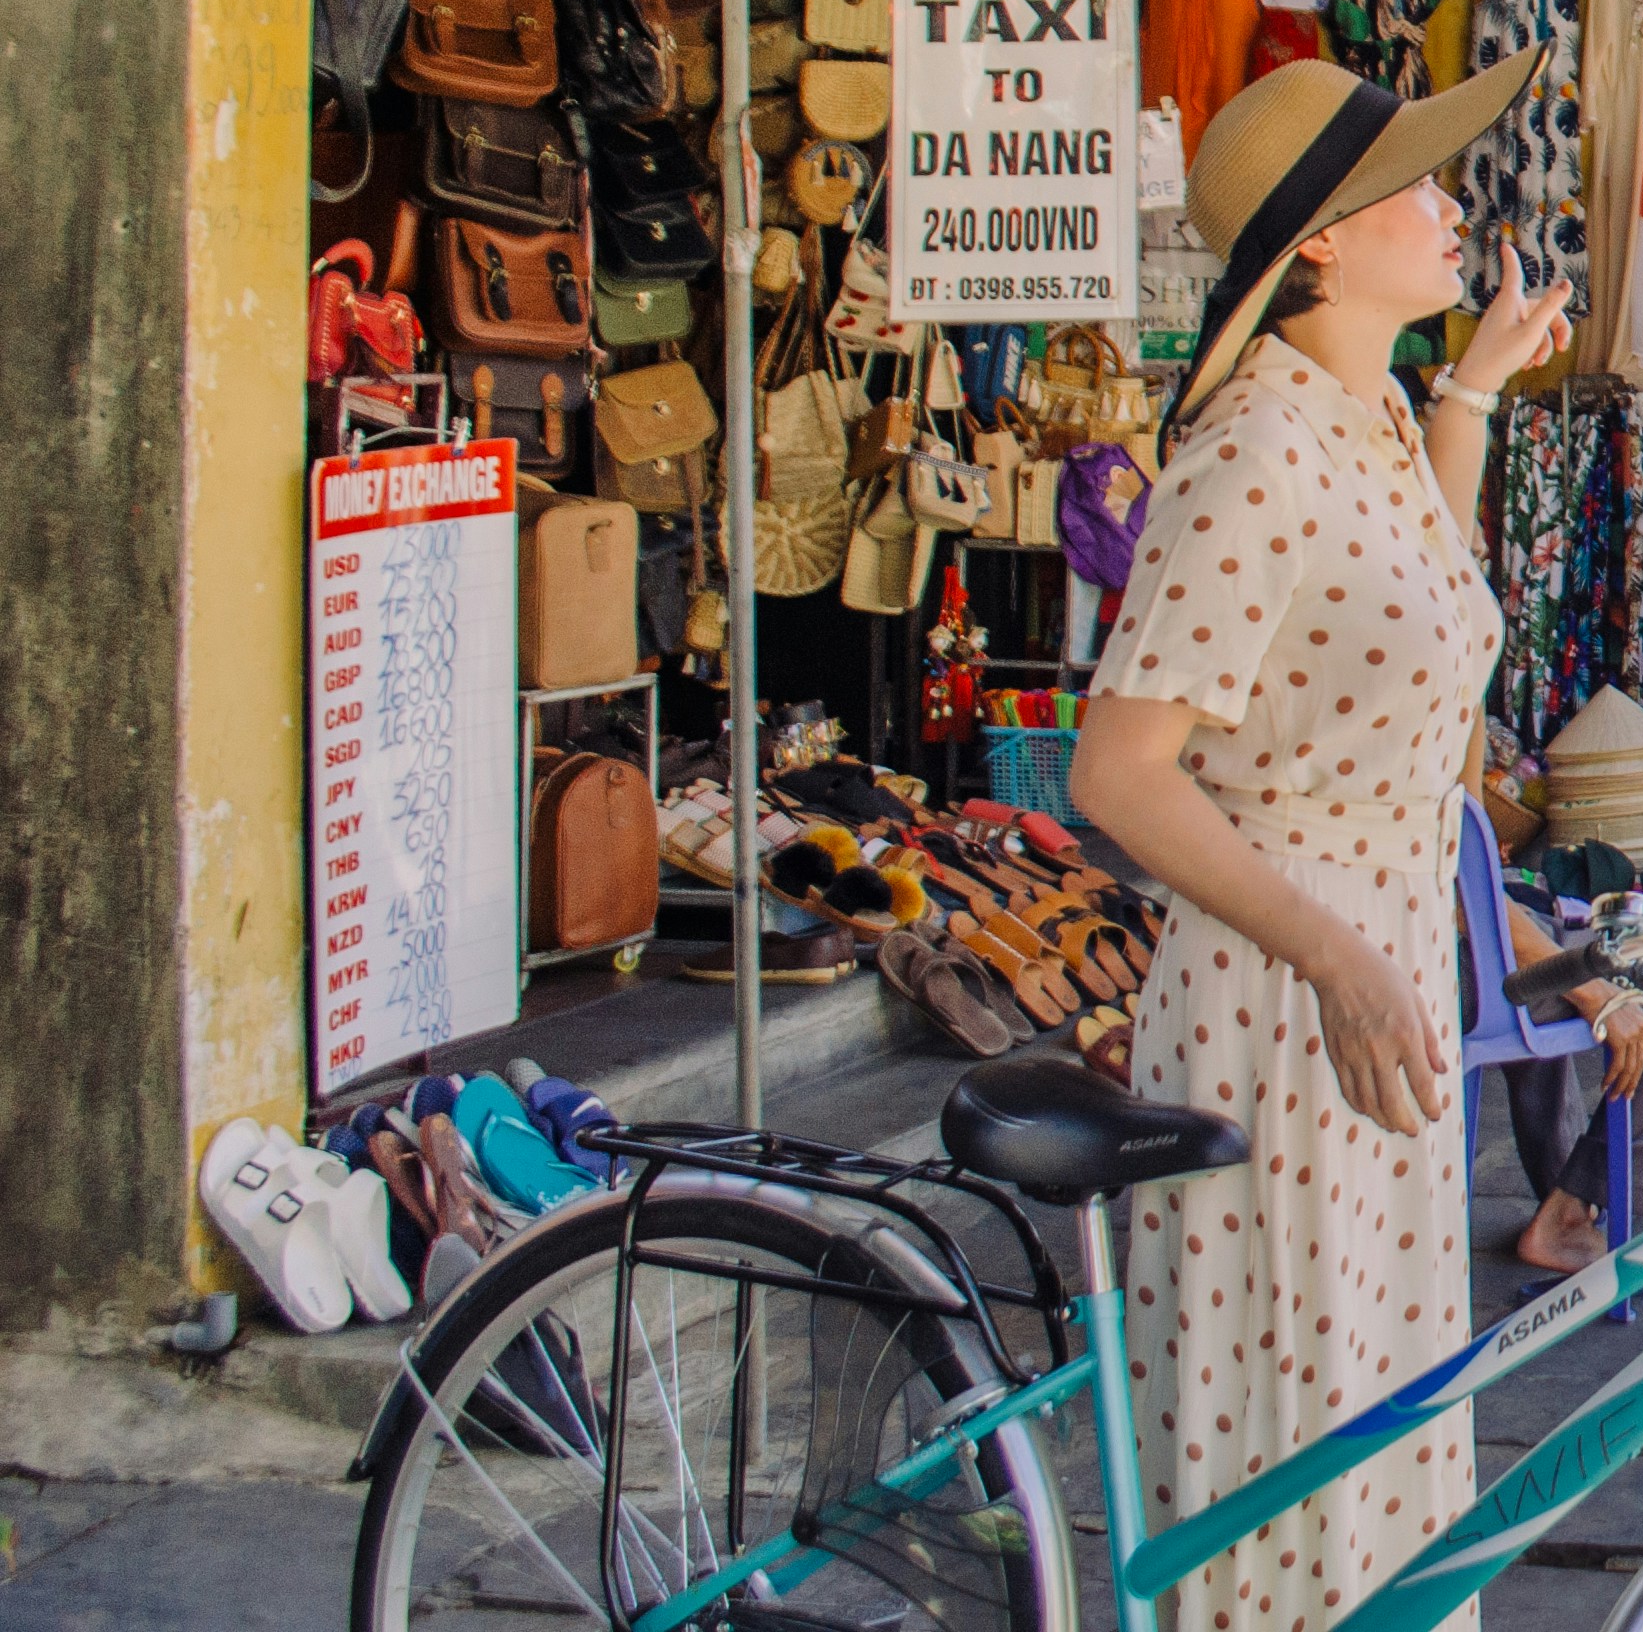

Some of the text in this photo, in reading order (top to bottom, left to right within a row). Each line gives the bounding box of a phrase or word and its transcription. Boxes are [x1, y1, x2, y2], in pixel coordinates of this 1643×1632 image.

[984, 68, 1042, 102] TO
[911, 129, 1112, 176] DA NANG
[923, 206, 1098, 252] 240.000VND
[960, 276, 1111, 300] 0398.955.720
[324, 455, 500, 522] MONEY EXCHANGE
[324, 553, 360, 579] USD
[324, 591, 358, 617] EUR
[324, 627, 362, 655] AUD
[324, 665, 361, 692] GBP
[324, 701, 362, 730] CAD
[325, 739, 361, 767] SGD
[325, 777, 356, 806] JPY
[326, 812, 363, 844] CNY
[326, 851, 360, 881] THB
[327, 884, 368, 918] KRW
[327, 925, 363, 956] NZD
[328, 959, 368, 994] MYR
[329, 998, 362, 1031] CHF
[330, 1035, 365, 1069] HKD
[1497, 1285, 1587, 1354] ASAMA
